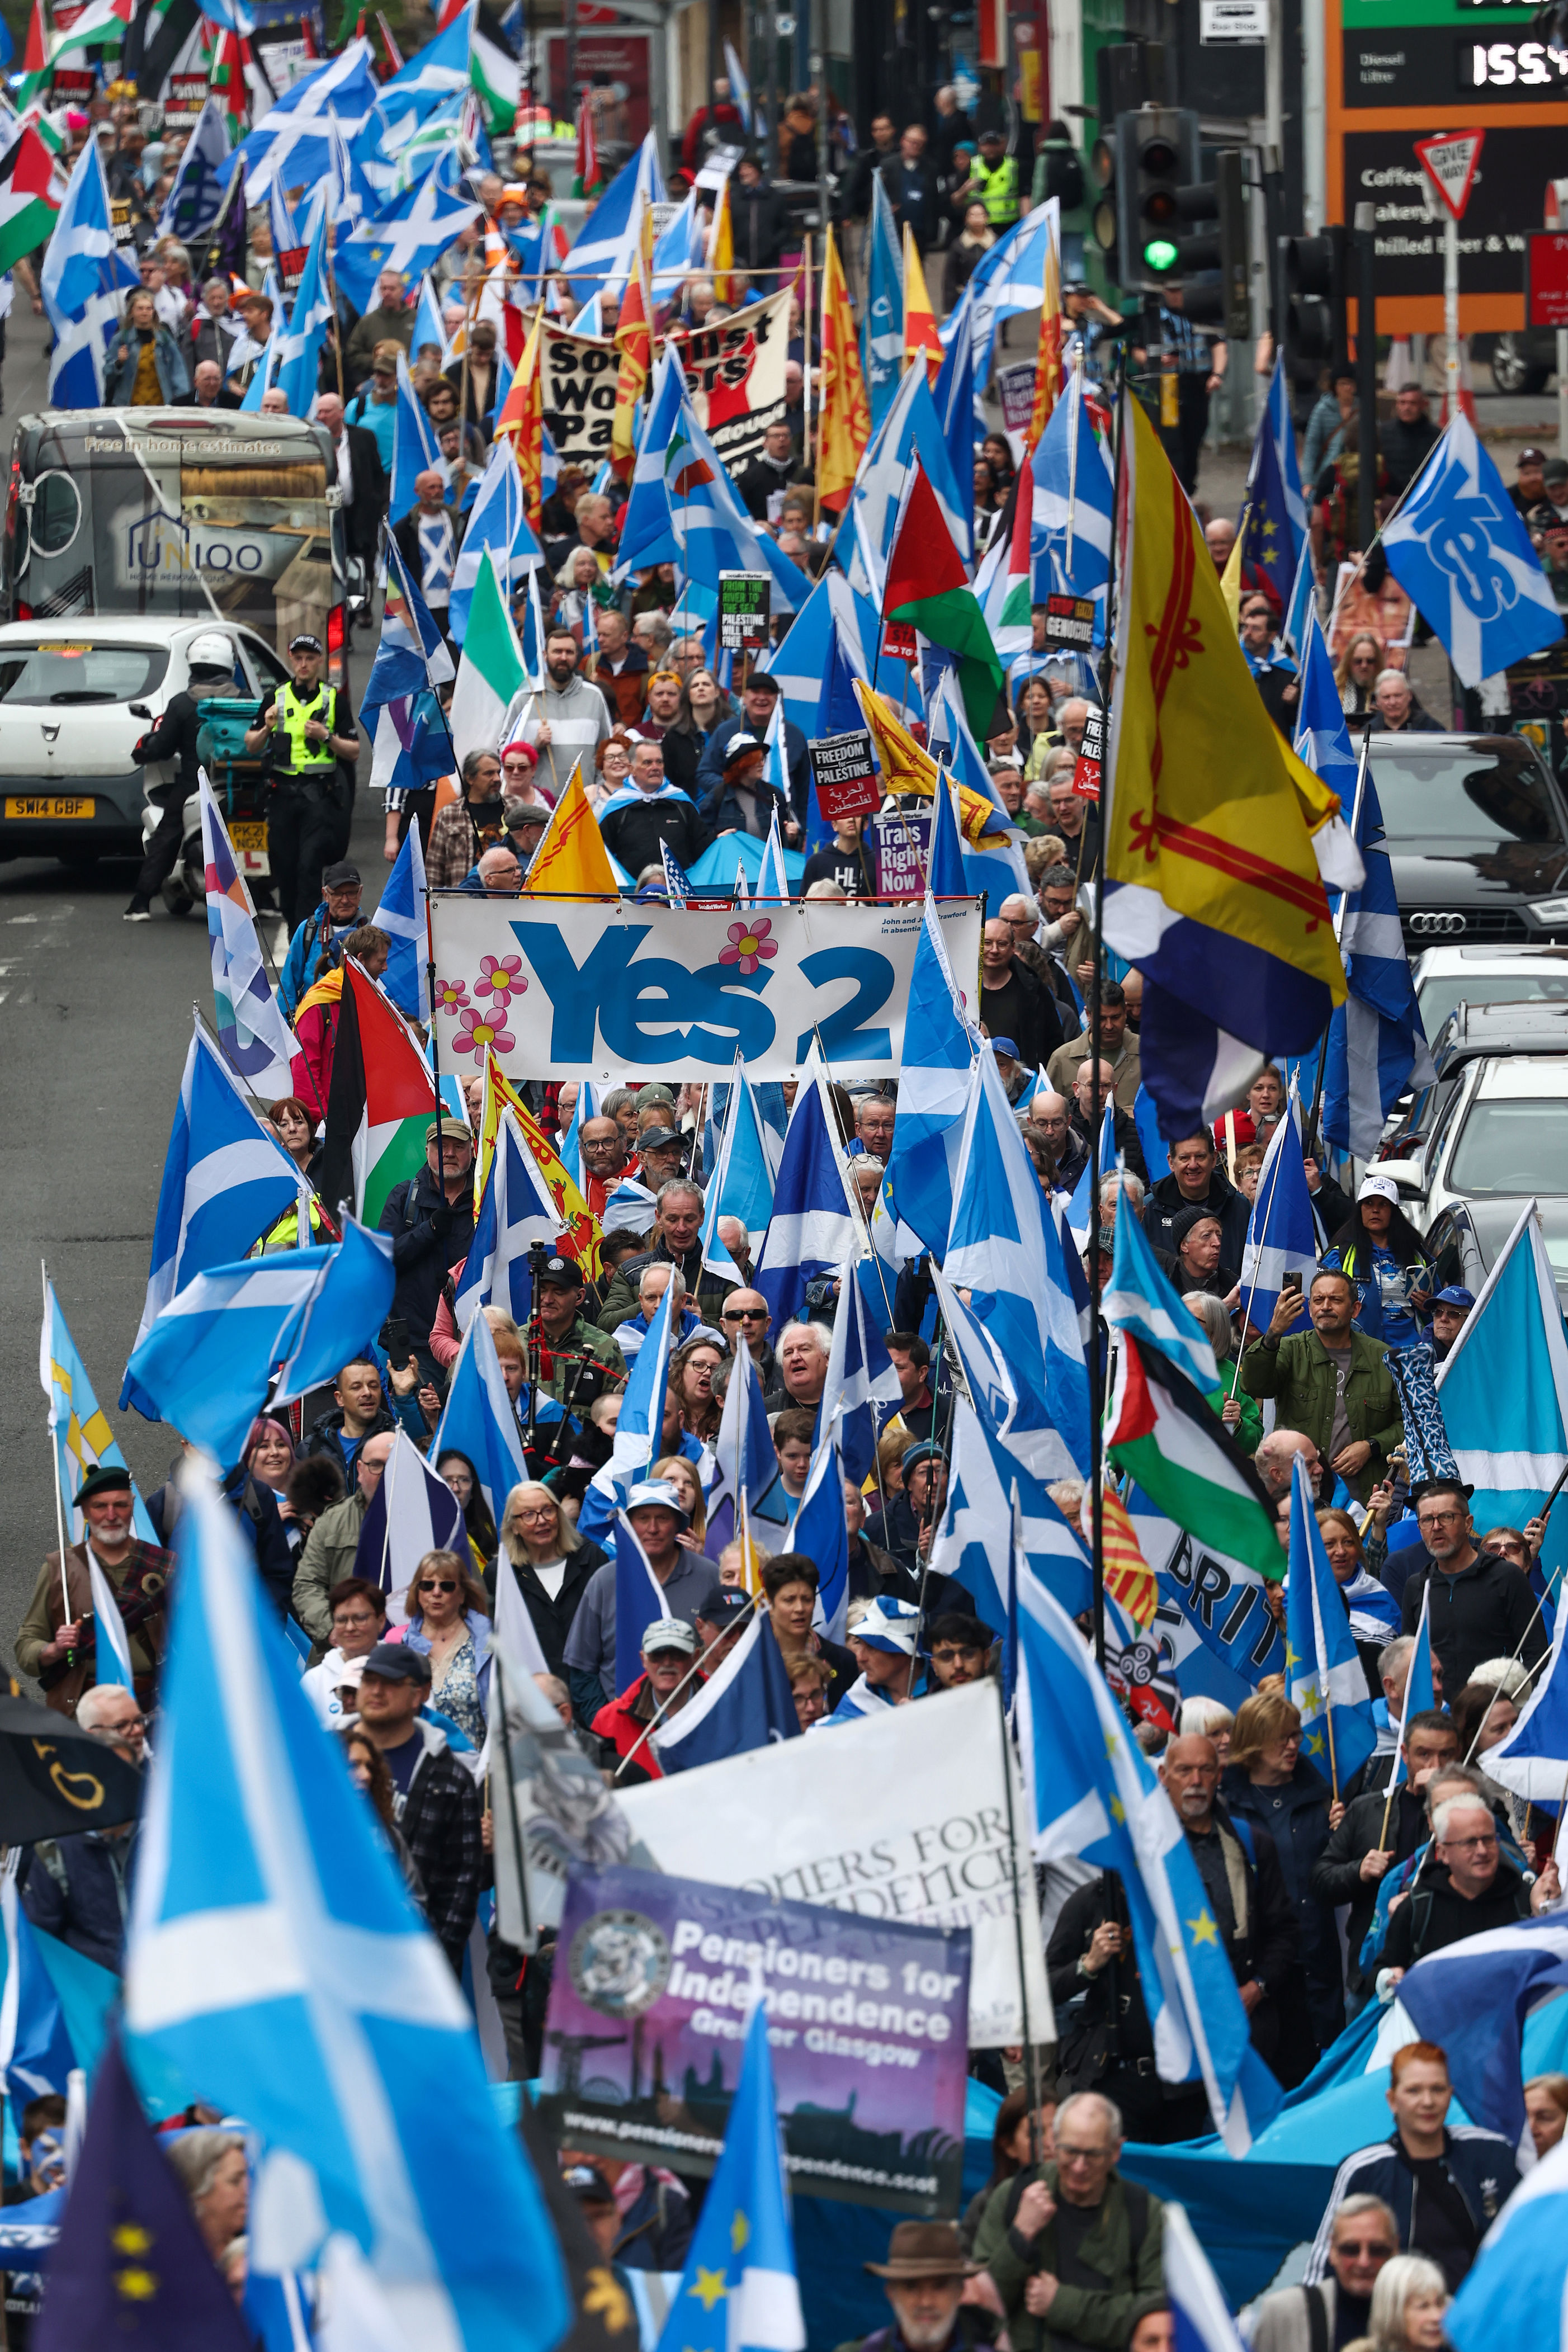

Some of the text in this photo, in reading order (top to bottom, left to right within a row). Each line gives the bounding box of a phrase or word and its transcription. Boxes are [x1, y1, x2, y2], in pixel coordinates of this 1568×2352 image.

[1430, 142, 1471, 167] GIVE
[1441, 165, 1465, 180] WAY
[1375, 202, 1432, 225] akery
[1375, 235, 1433, 256] hilled
[1435, 235, 1482, 254] Ber
[1485, 234, 1503, 252] &
[84, 436, 282, 455] Free in-home estimates
[1413, 460, 1520, 622] Yes
[722, 580, 763, 593] FROM THE
[722, 592, 761, 603] RIVER TO
[1048, 596, 1075, 616] STOP
[739, 603, 755, 613] SEA
[721, 613, 766, 626] PALESTINE
[722, 625, 755, 637] WILL BE
[1046, 615, 1093, 644] GENOCIDE
[722, 636, 743, 648] FREE
[884, 644, 914, 657] NO TO
[815, 742, 865, 765] FREEDOM
[816, 761, 872, 784] PALESTINE
[838, 760, 847, 768] for
[829, 782, 865, 801] الحرية
[16, 800, 84, 815] SW14 GBF
[828, 793, 873, 815] لفلسطين
[233, 824, 265, 838] PK21
[876, 823, 922, 846] Trans
[236, 837, 265, 849] NGX
[244, 851, 262, 869] L
[880, 844, 929, 873] Rights
[882, 871, 917, 894] Now
[508, 919, 895, 1065] Yes 2
[1364, 1177, 1395, 1190] PATRIOT
[911, 1806, 1012, 1863] FOR
[670, 1919, 890, 1992] Pensioners
[901, 1959, 962, 2002] for
[689, 2007, 922, 2069] Greer Glasgow
